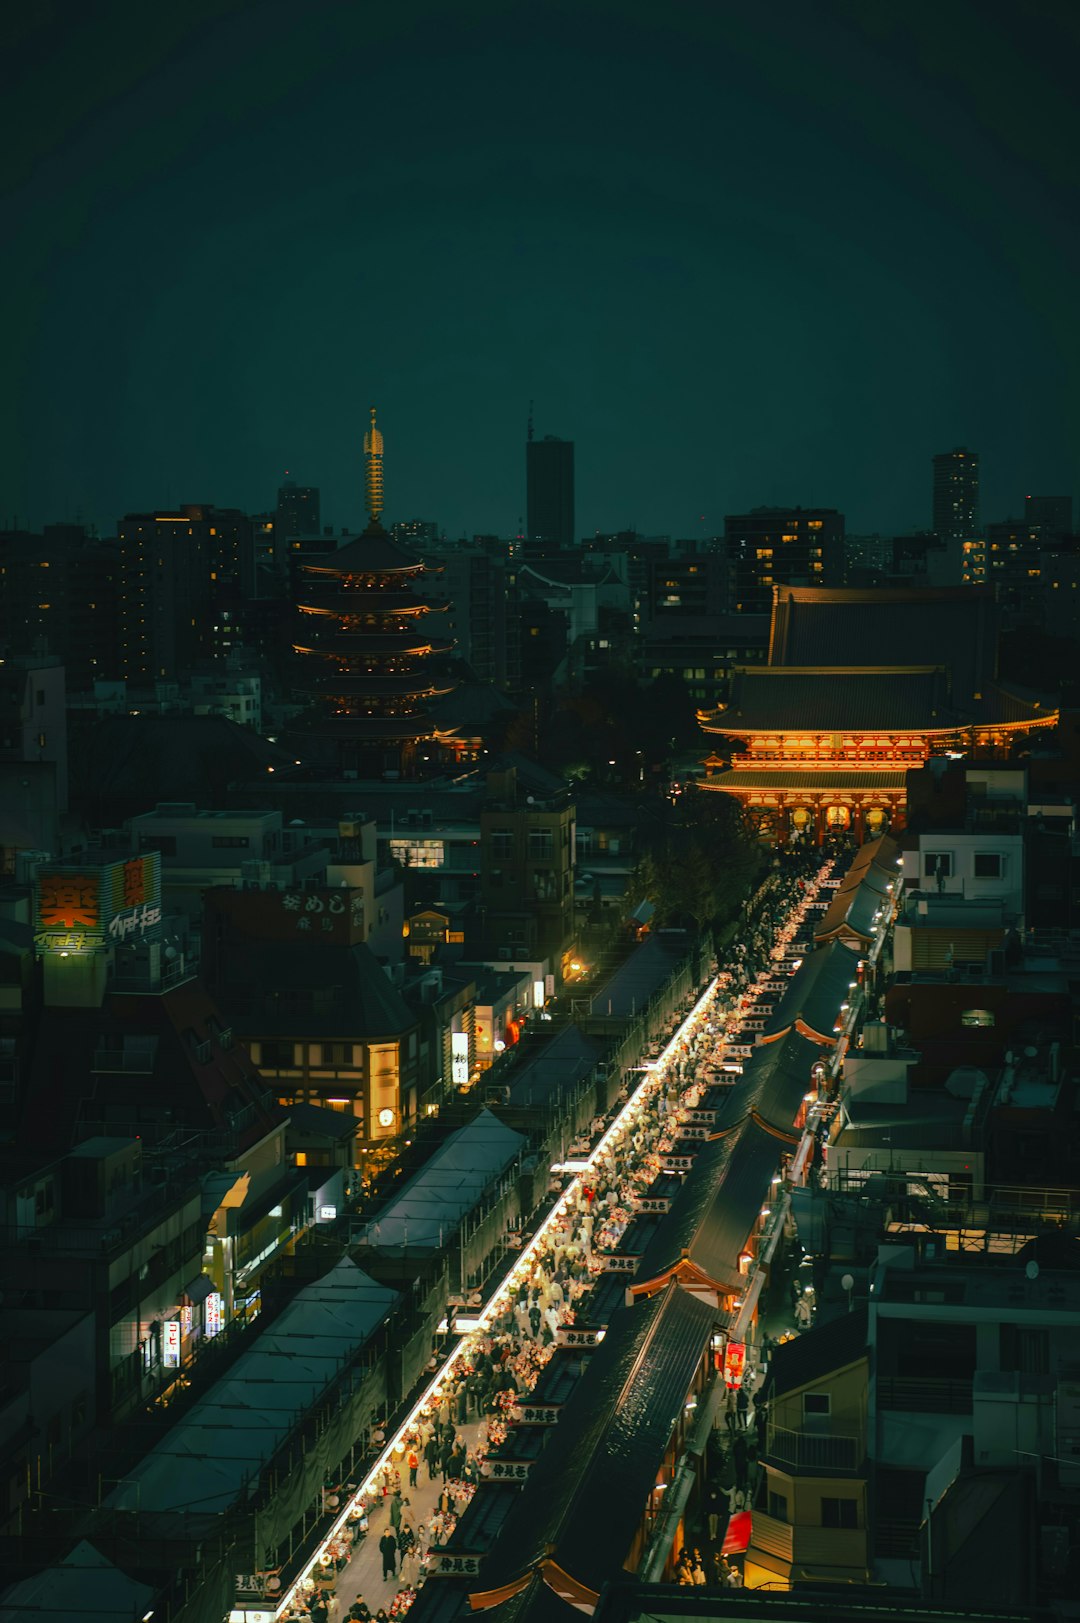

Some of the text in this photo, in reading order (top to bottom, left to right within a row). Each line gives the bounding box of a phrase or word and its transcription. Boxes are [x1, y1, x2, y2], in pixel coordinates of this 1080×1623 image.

[40, 873, 97, 927] 薬
[280, 893, 346, 914] 釜めし
[169, 1323, 177, 1351] コーヒー
